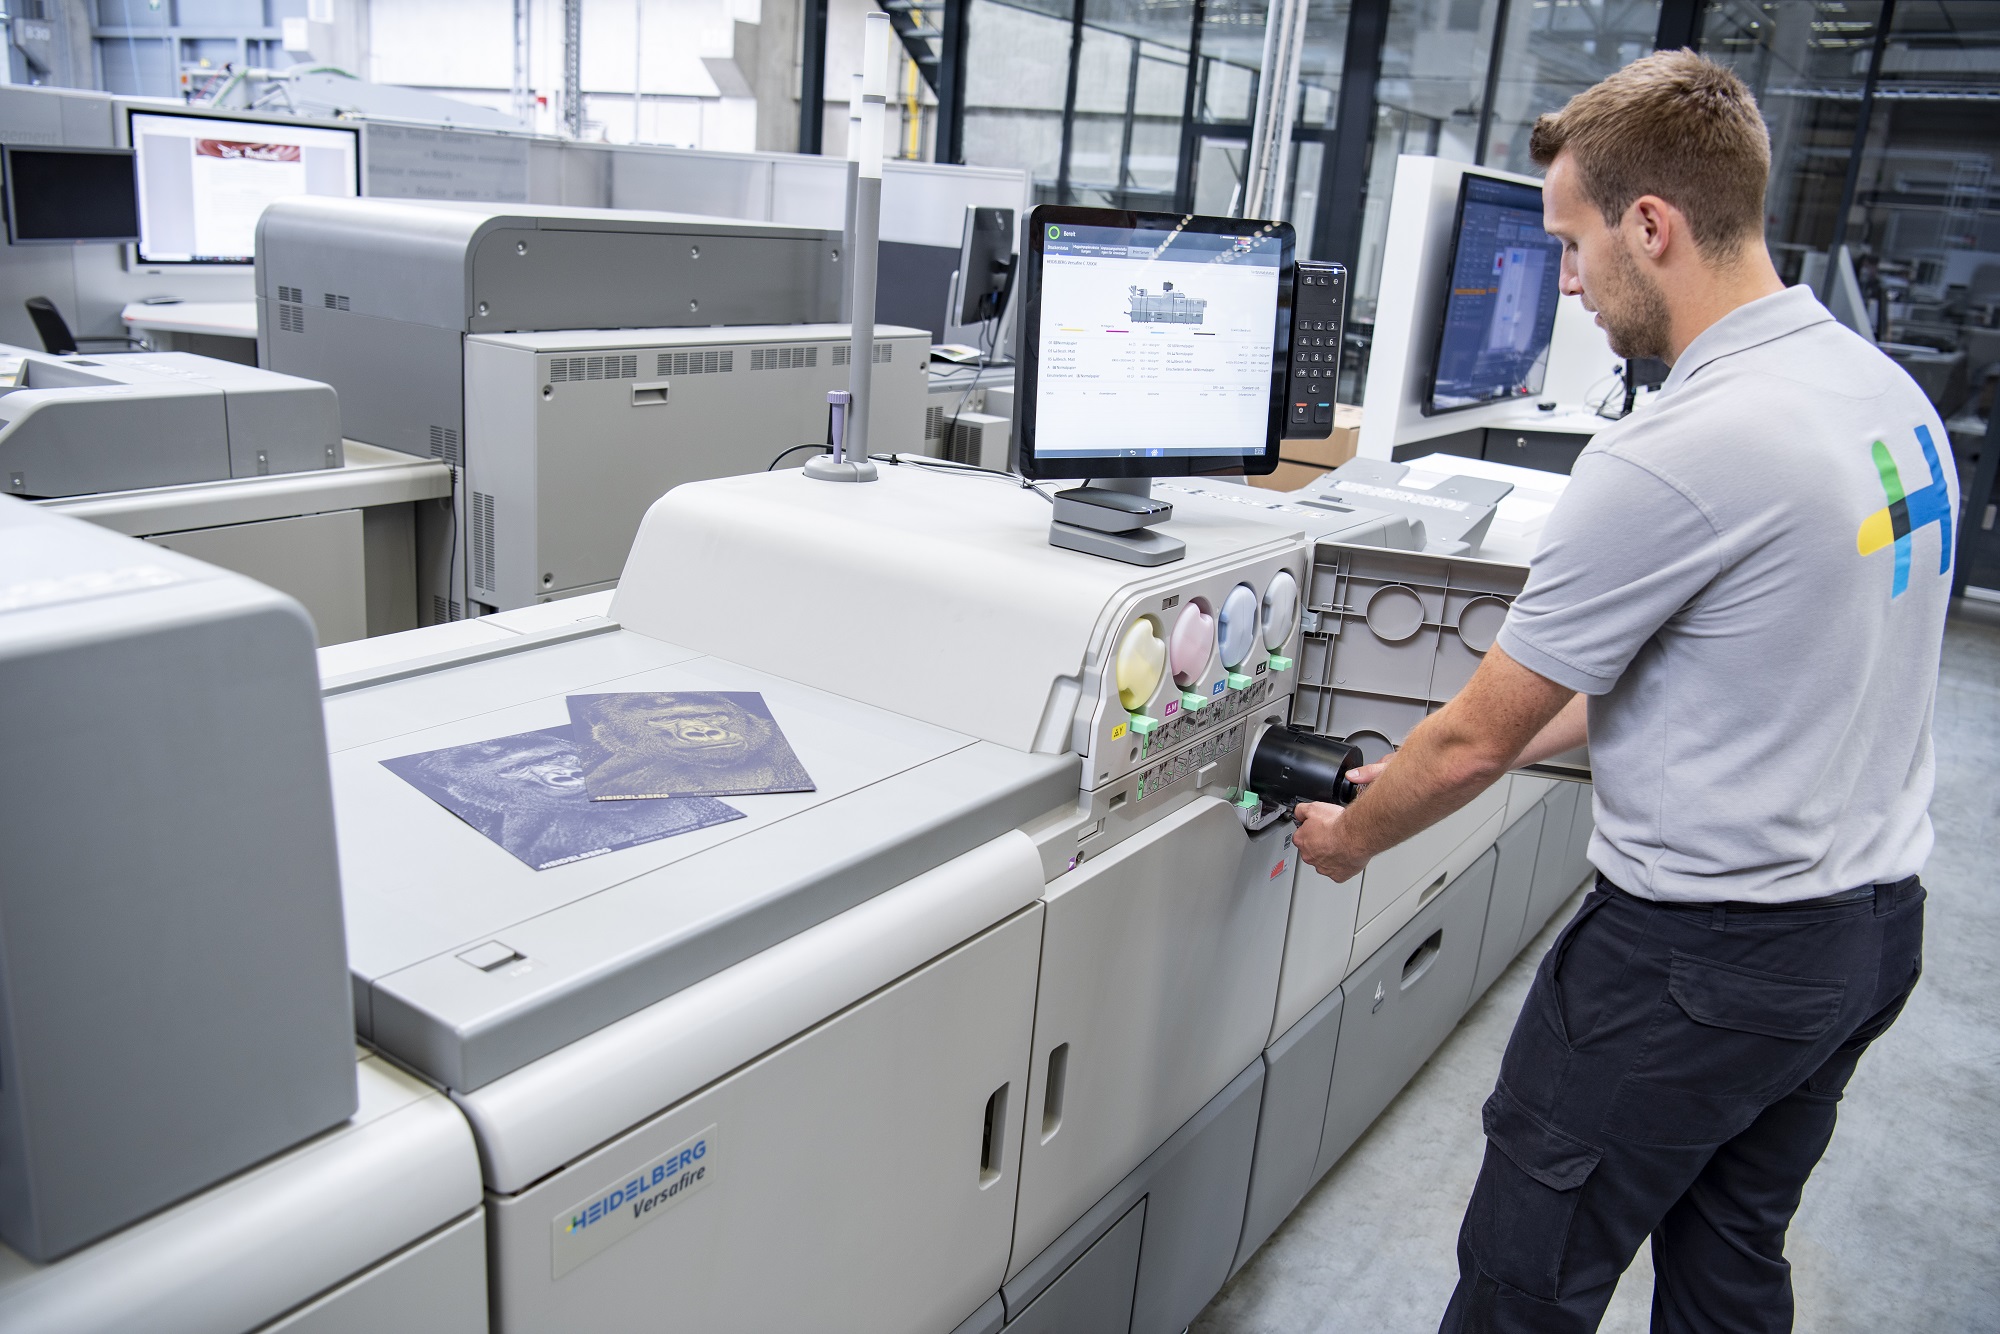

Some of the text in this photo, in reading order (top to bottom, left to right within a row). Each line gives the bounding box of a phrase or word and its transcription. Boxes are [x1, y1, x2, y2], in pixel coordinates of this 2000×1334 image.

[1317, 322, 1322, 330] 2
[1330, 322, 1335, 330] 3
[1329, 338, 1334, 346] 6
[1314, 353, 1319, 361] 8
[1327, 354, 1332, 362] 9
[594, 793, 670, 801] HEIDELBERG
[539, 847, 612, 869] HEIDELBERG
[1374, 980, 1382, 1000] 4
[565, 1140, 706, 1235] HEIDELBERG
[633, 1166, 706, 1219] Versafire
